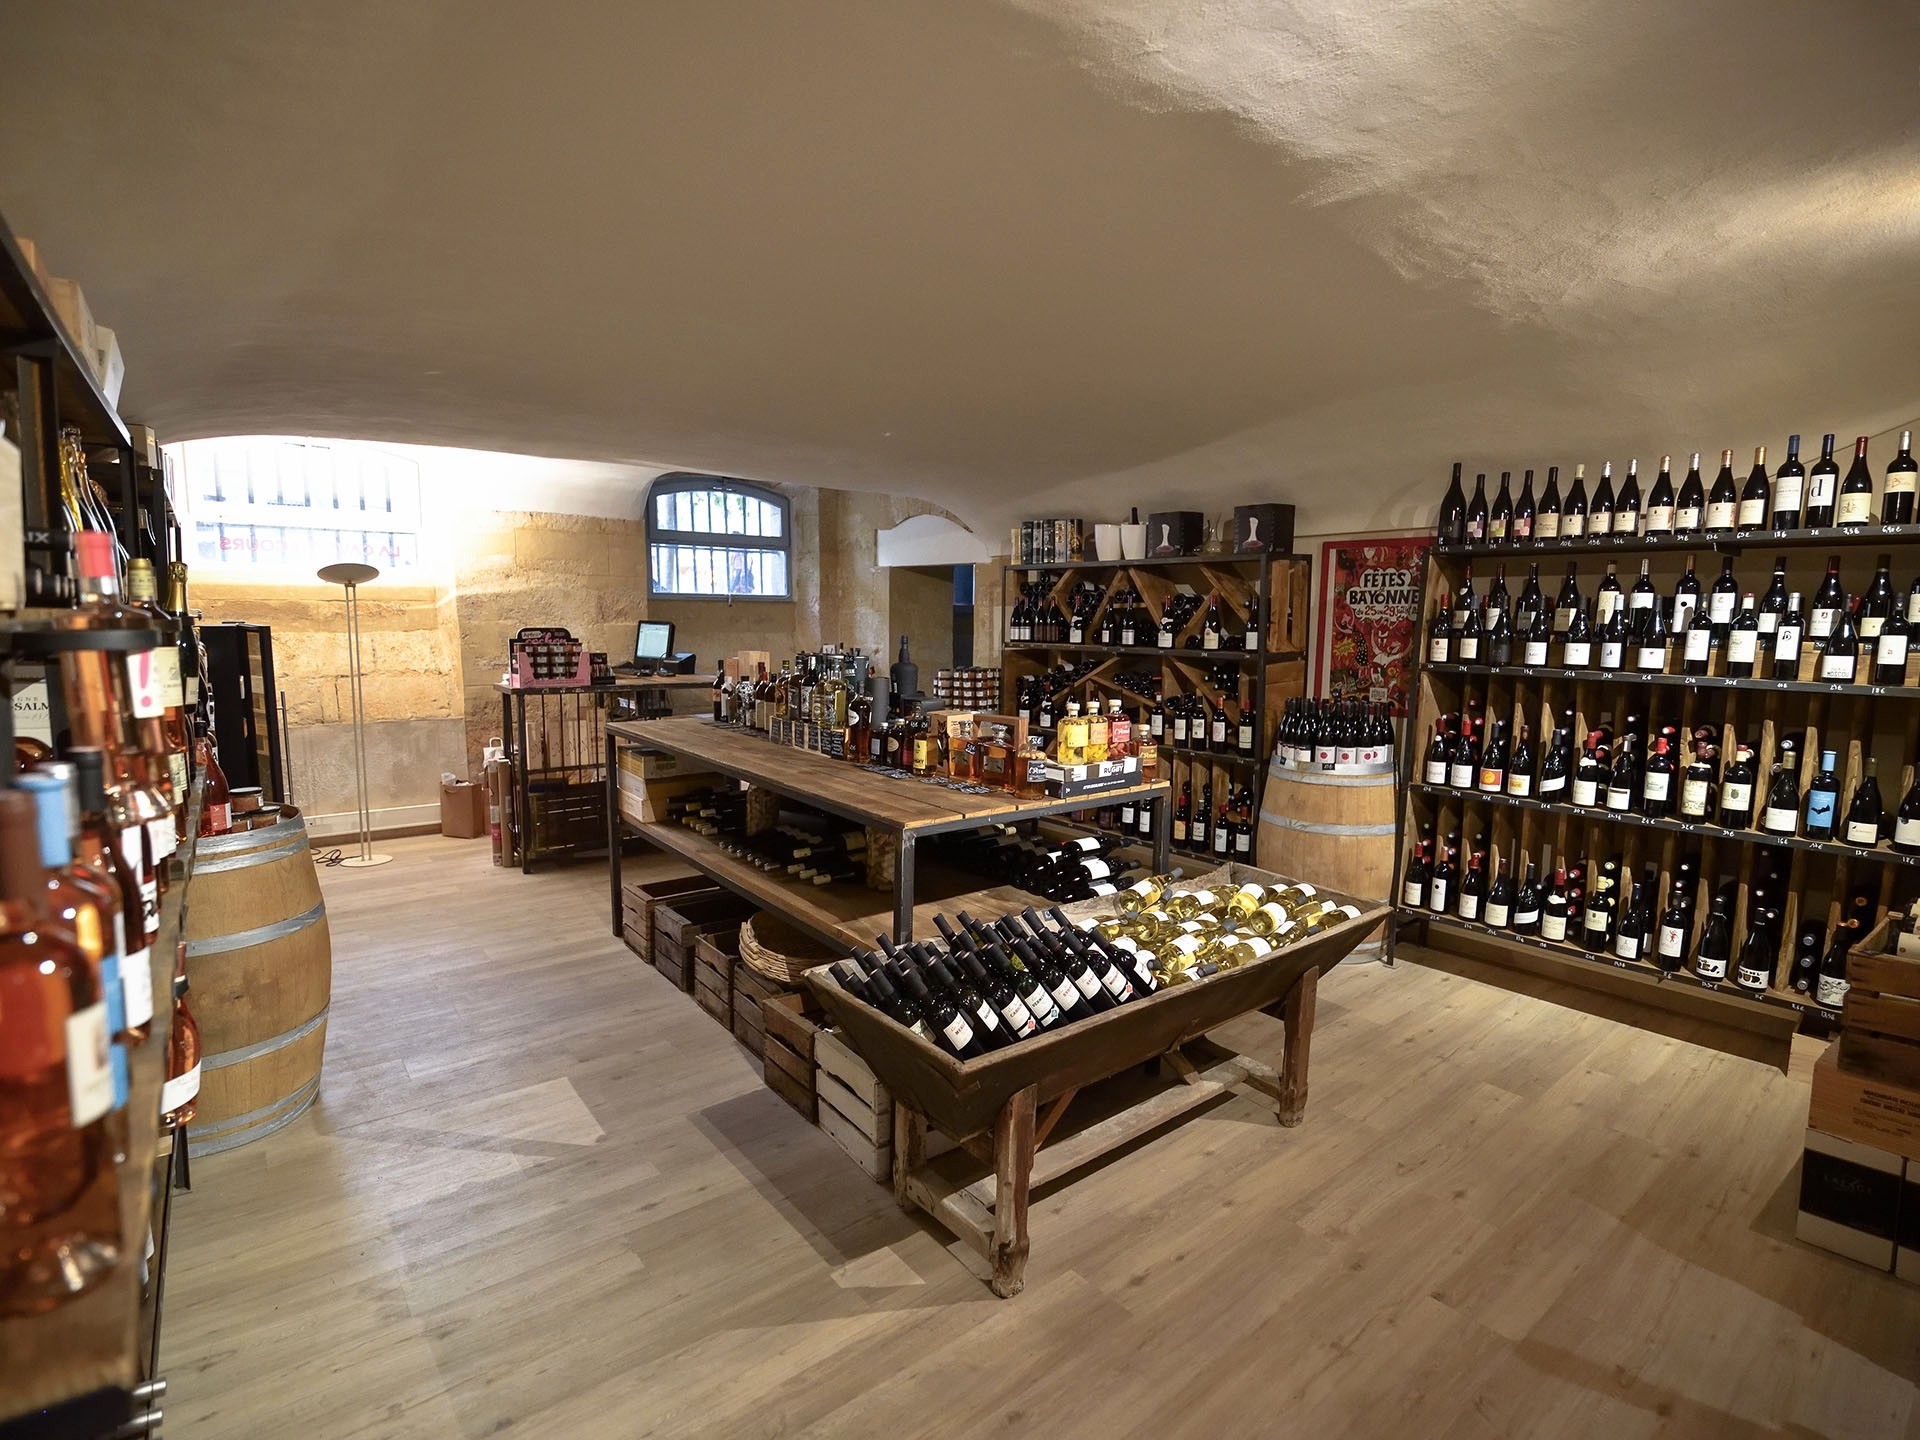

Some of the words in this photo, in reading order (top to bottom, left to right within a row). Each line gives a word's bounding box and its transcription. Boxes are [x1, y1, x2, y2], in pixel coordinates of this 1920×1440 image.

[1364, 568, 1407, 588] FÊTES
[1349, 589, 1420, 605] BAYONNE
[1364, 605, 1378, 616] 25
[1383, 605, 1396, 617] 29
[1103, 765, 1124, 774] RUGBY
